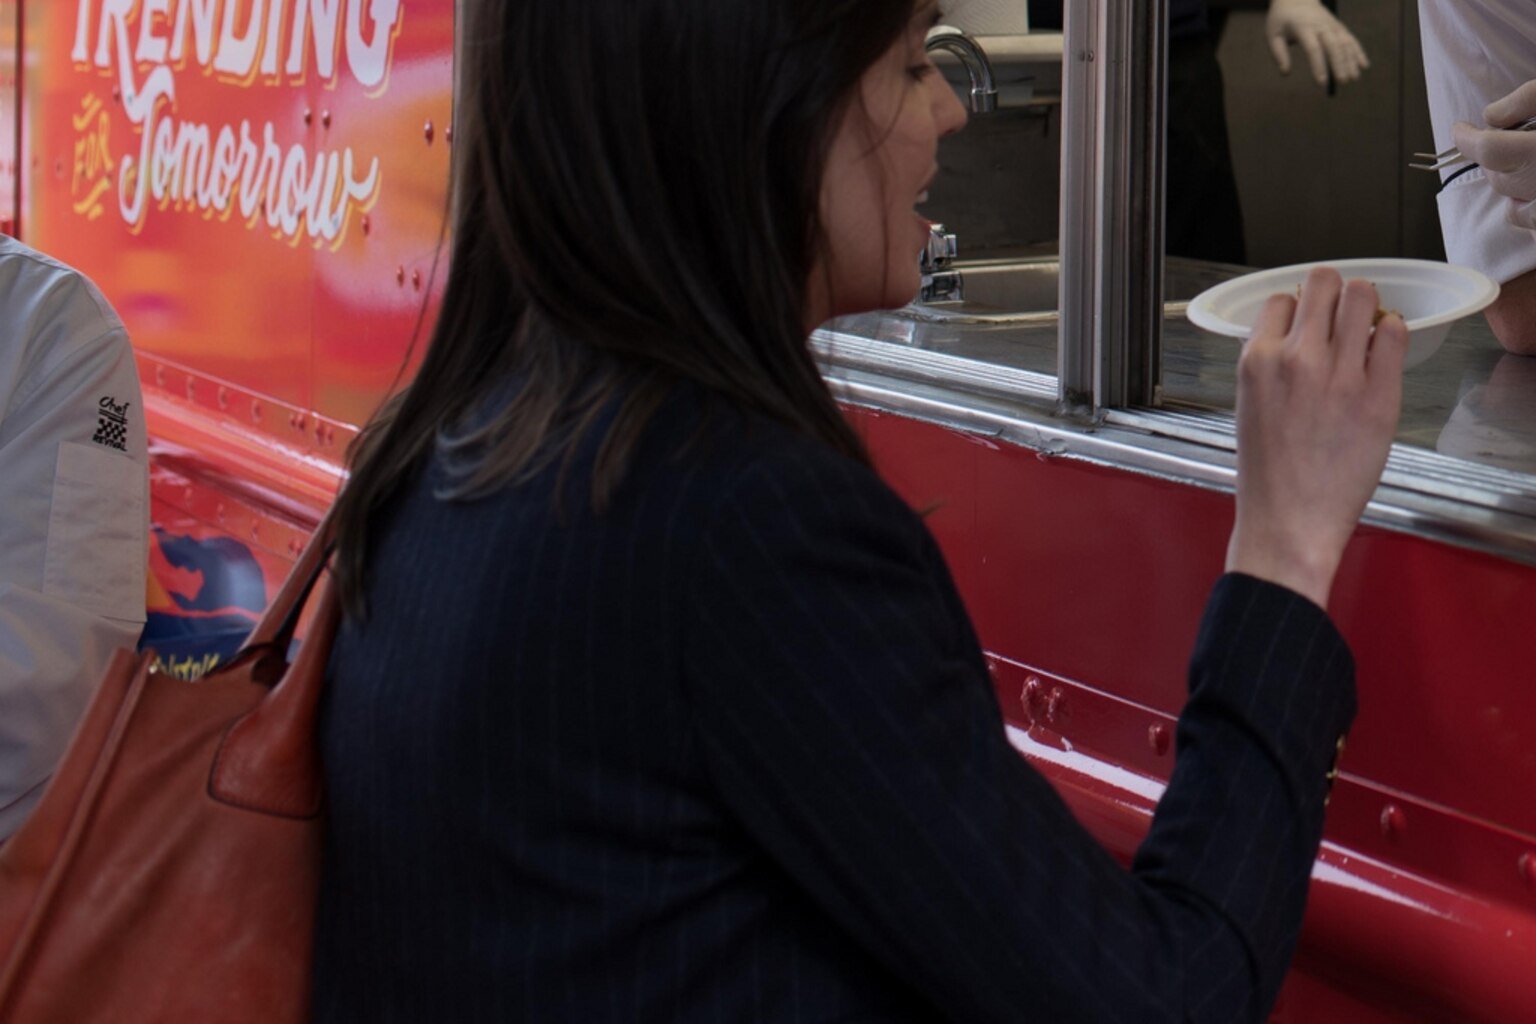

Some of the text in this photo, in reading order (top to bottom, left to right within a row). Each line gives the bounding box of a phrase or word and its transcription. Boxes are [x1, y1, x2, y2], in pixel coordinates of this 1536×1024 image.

[71, 110, 114, 195] FOR
[119, 65, 379, 240] Tomorrow
[99, 396, 130, 419] Chef
